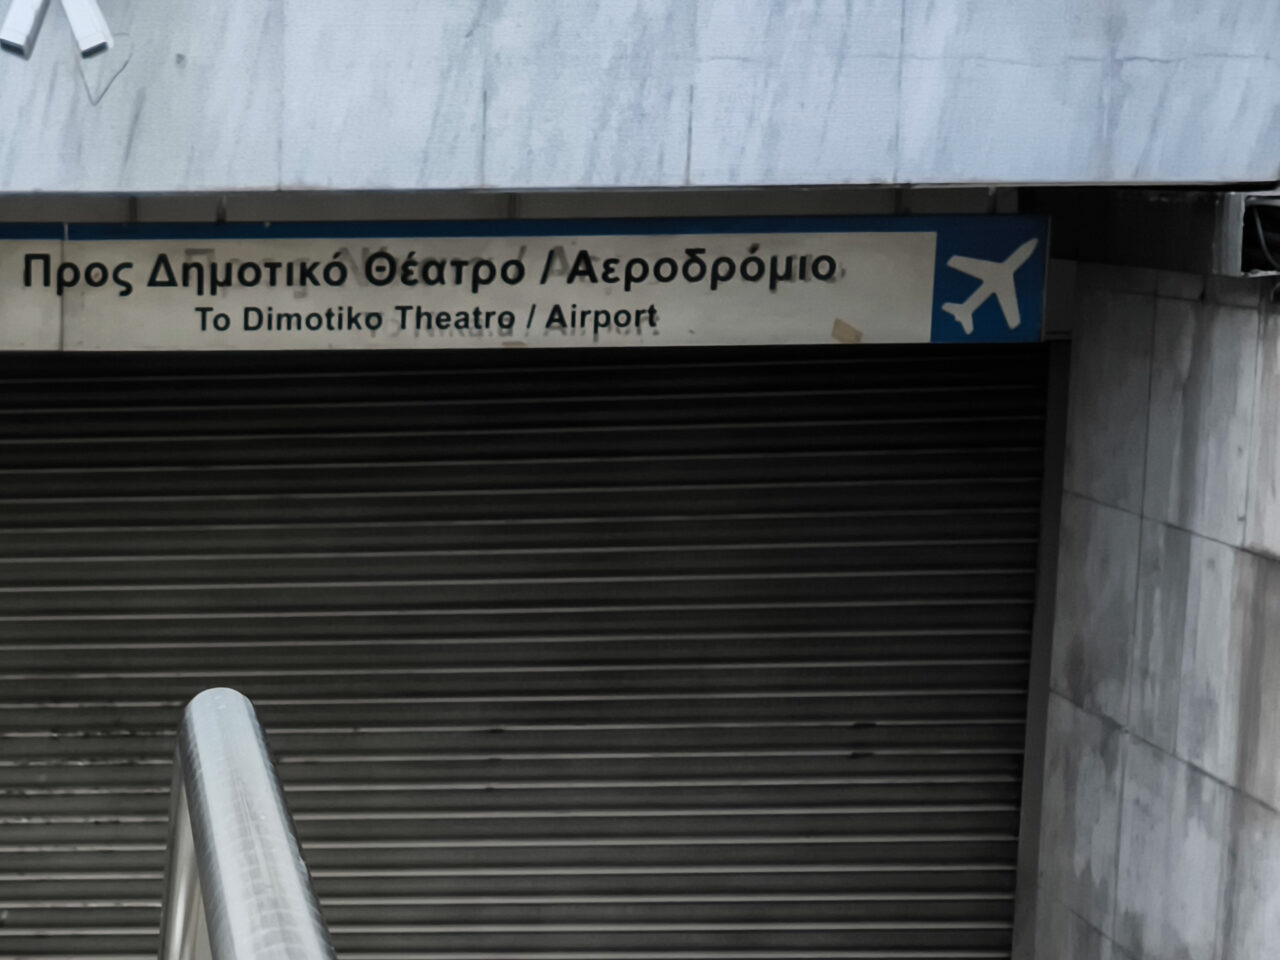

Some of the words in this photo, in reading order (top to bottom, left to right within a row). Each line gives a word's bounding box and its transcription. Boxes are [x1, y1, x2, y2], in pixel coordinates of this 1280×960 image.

[22, 253, 134, 297] Προς
[147, 250, 348, 296] Δημοτικό
[364, 249, 526, 294] Θέατρο
[566, 242, 838, 292] Αεροδρόμιο
[195, 306, 231, 332] To
[243, 305, 384, 332] Dimotiko
[393, 304, 516, 331] Theatro
[544, 303, 658, 335] Airport
